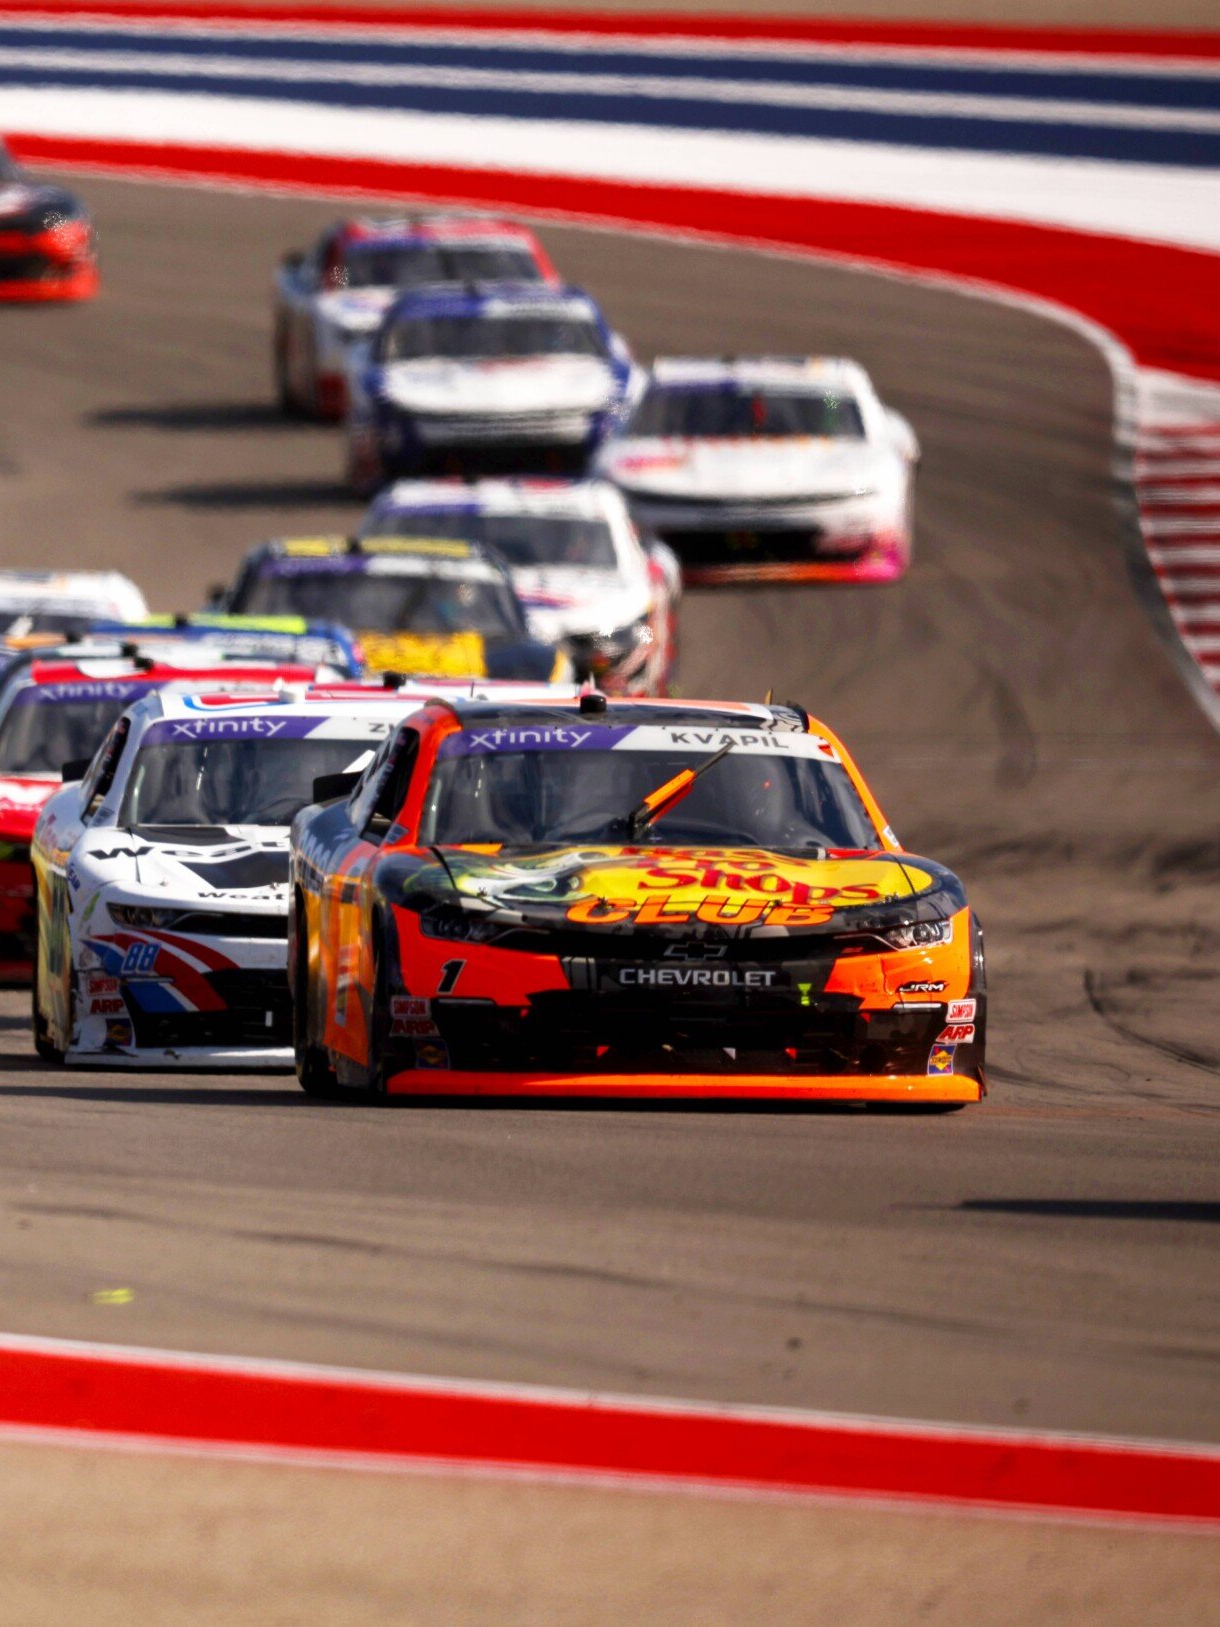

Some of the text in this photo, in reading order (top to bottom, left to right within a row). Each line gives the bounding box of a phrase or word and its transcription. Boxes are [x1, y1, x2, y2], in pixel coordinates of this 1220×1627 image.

[39, 682, 133, 700] xfinity
[171, 717, 287, 738] xfinity
[469, 728, 790, 750] xfinity KVAPIL
[638, 866, 881, 905] Shops
[566, 895, 835, 926] CLUB
[121, 942, 160, 974] 88
[436, 958, 467, 995] 1
[619, 968, 776, 986] CHEVROLET
[899, 983, 944, 992] JRM
[90, 999, 124, 1014] ARP
[938, 1025, 974, 1040] ARP
